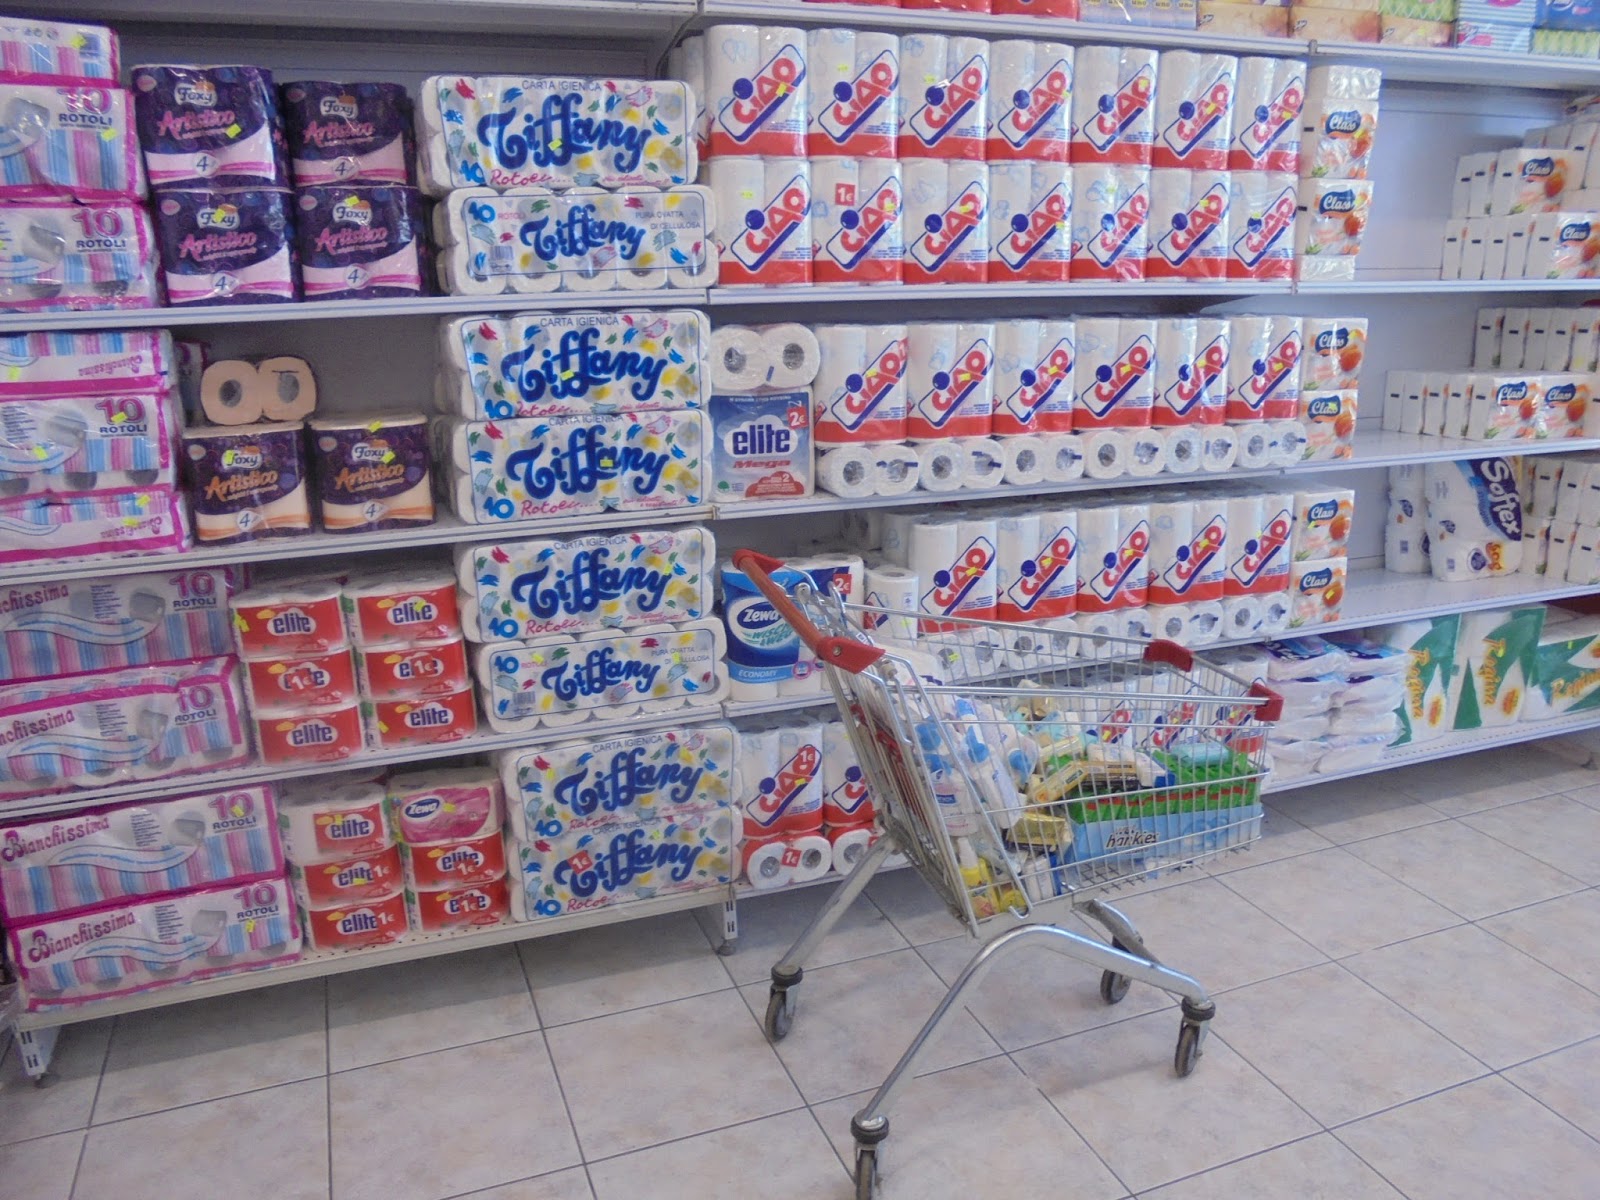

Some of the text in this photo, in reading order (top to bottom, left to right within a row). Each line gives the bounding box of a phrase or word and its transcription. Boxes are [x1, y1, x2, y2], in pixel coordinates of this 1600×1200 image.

[178, 87, 213, 104] Foxy
[522, 80, 602, 92] CARTA IGIENICA
[733, 58, 796, 123] CIAO
[833, 63, 892, 126] CIAO
[924, 67, 982, 129] CIAO
[323, 100, 354, 116] Foxy
[1012, 71, 1067, 131] CIAO
[1097, 76, 1150, 135] CIAO
[59, 113, 112, 126] ROTOLI
[158, 110, 236, 139] Artistico
[477, 93, 652, 173] Tiffany
[195, 159, 208, 171] 4
[335, 162, 346, 175] 4
[72, 210, 124, 240] 10
[335, 206, 369, 221] Foxy
[745, 188, 805, 253] CIAO
[840, 189, 897, 252] CIAO
[924, 193, 981, 255] CIAO
[1010, 194, 1065, 254] CIAO
[1100, 195, 1148, 251] CIAO
[1170, 194, 1222, 250] CIAO
[76, 239, 126, 249] ROTOLI
[180, 232, 257, 260] Artistico
[520, 204, 646, 261] Tiffany
[215, 278, 227, 290] 4
[348, 269, 359, 283] 4
[540, 316, 619, 327] CARTA IGIENICA
[501, 328, 667, 402] Tiffany
[845, 353, 900, 414] CIAO
[931, 350, 986, 411] CIAO
[95, 398, 146, 425] 10
[789, 411, 805, 427] 2€
[100, 424, 147, 433] ROTOLI
[732, 424, 791, 455] elite
[506, 425, 670, 499] Tiffany
[205, 471, 279, 502] Artistico
[335, 464, 405, 492] Artistico
[366, 504, 376, 517] 4
[1481, 459, 1520, 534] Softex
[239, 513, 250, 527] 4
[553, 537, 627, 550] CARTA IGIENICA
[1243, 520, 1287, 572] CIAO
[933, 548, 987, 607] CIAO
[1020, 538, 1070, 595] CIAO
[169, 572, 215, 599] 10
[511, 548, 672, 619] Tiffany
[835, 578, 850, 592] 2€
[172, 597, 217, 608] ROTOLI
[393, 603, 433, 623] elite
[743, 608, 780, 622] Zewa
[273, 612, 311, 634] elite
[541, 647, 661, 701] Tiffany
[738, 669, 778, 678] ECONOMY
[175, 709, 217, 723] ROTOLI
[410, 708, 449, 727] elite
[292, 725, 333, 745] elite
[592, 735, 663, 753] CARTA IGIENICA
[554, 747, 703, 817] Tiffany
[208, 791, 254, 820] 10
[408, 801, 437, 815] Zewa
[212, 817, 257, 830] ROTOLI
[331, 818, 370, 839] elite
[2, 817, 110, 862] Bianchissima
[554, 829, 702, 898] Tiffany
[233, 883, 277, 909] 10
[236, 905, 279, 919] ROTOLI
[28, 911, 136, 963] Bianchissima
